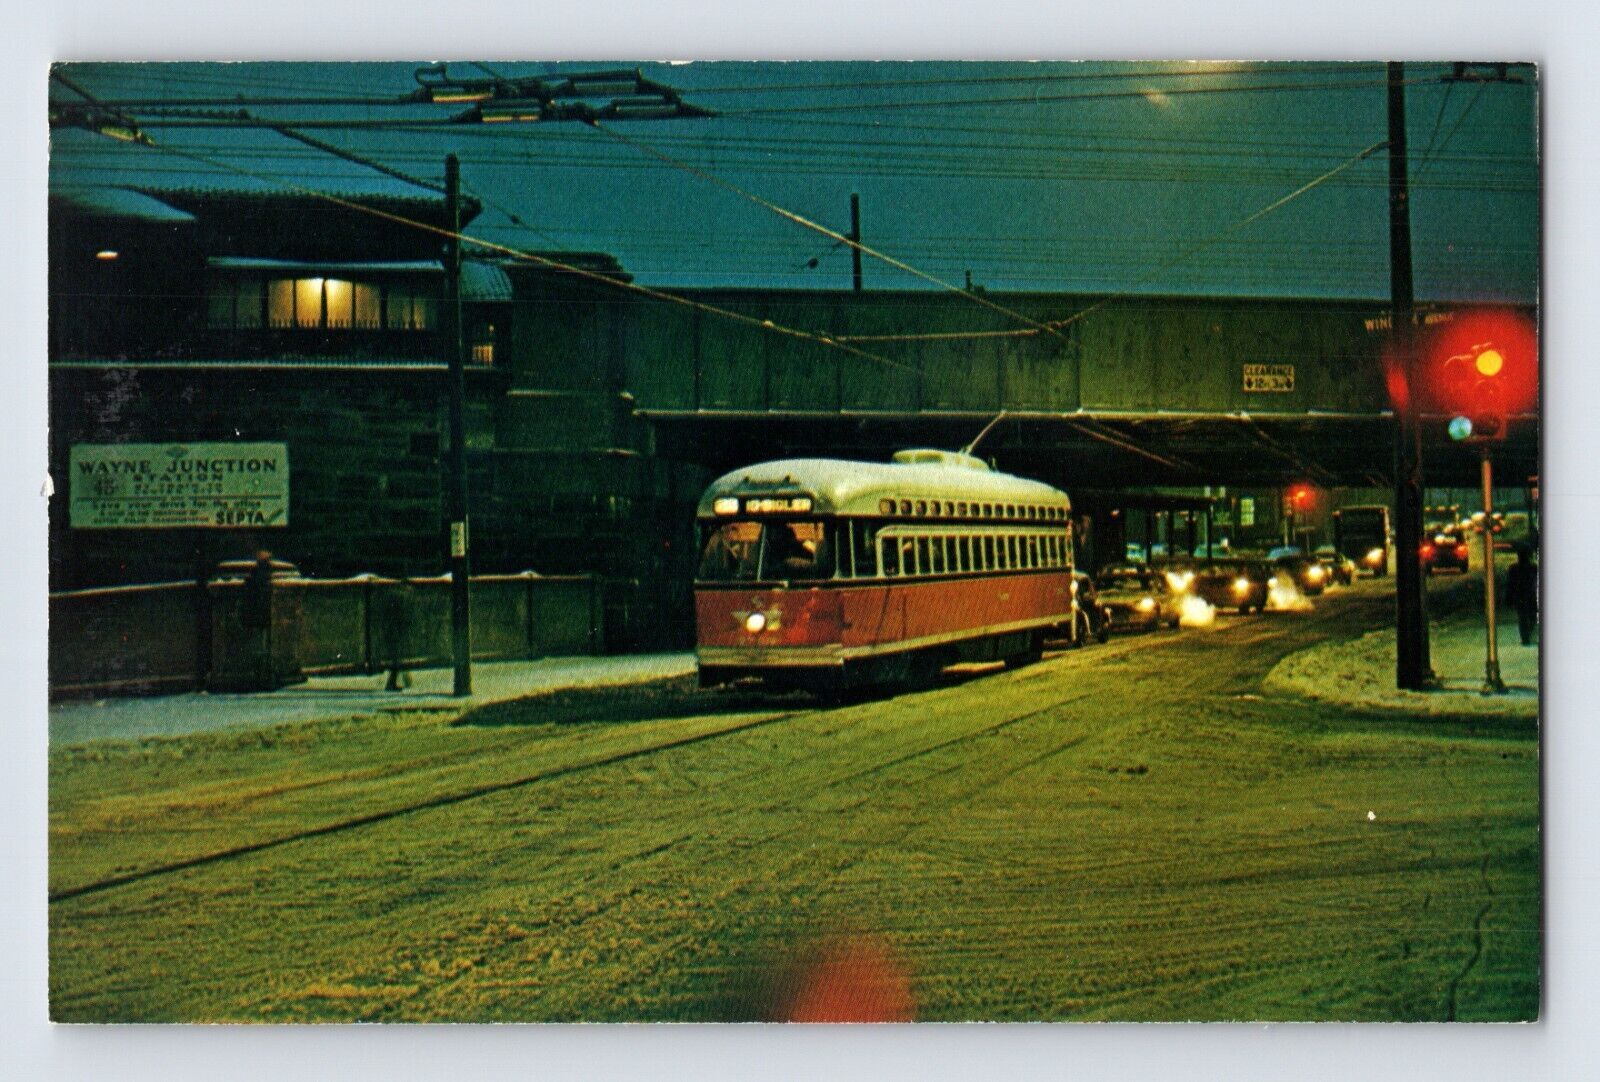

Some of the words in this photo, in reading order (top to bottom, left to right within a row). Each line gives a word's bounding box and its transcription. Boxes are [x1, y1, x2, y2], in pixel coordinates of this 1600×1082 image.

[79, 458, 152, 475] WAYNE
[165, 457, 277, 474] JUNCTION
[133, 473, 224, 483] STATION
[215, 510, 266, 525] SEPTA
